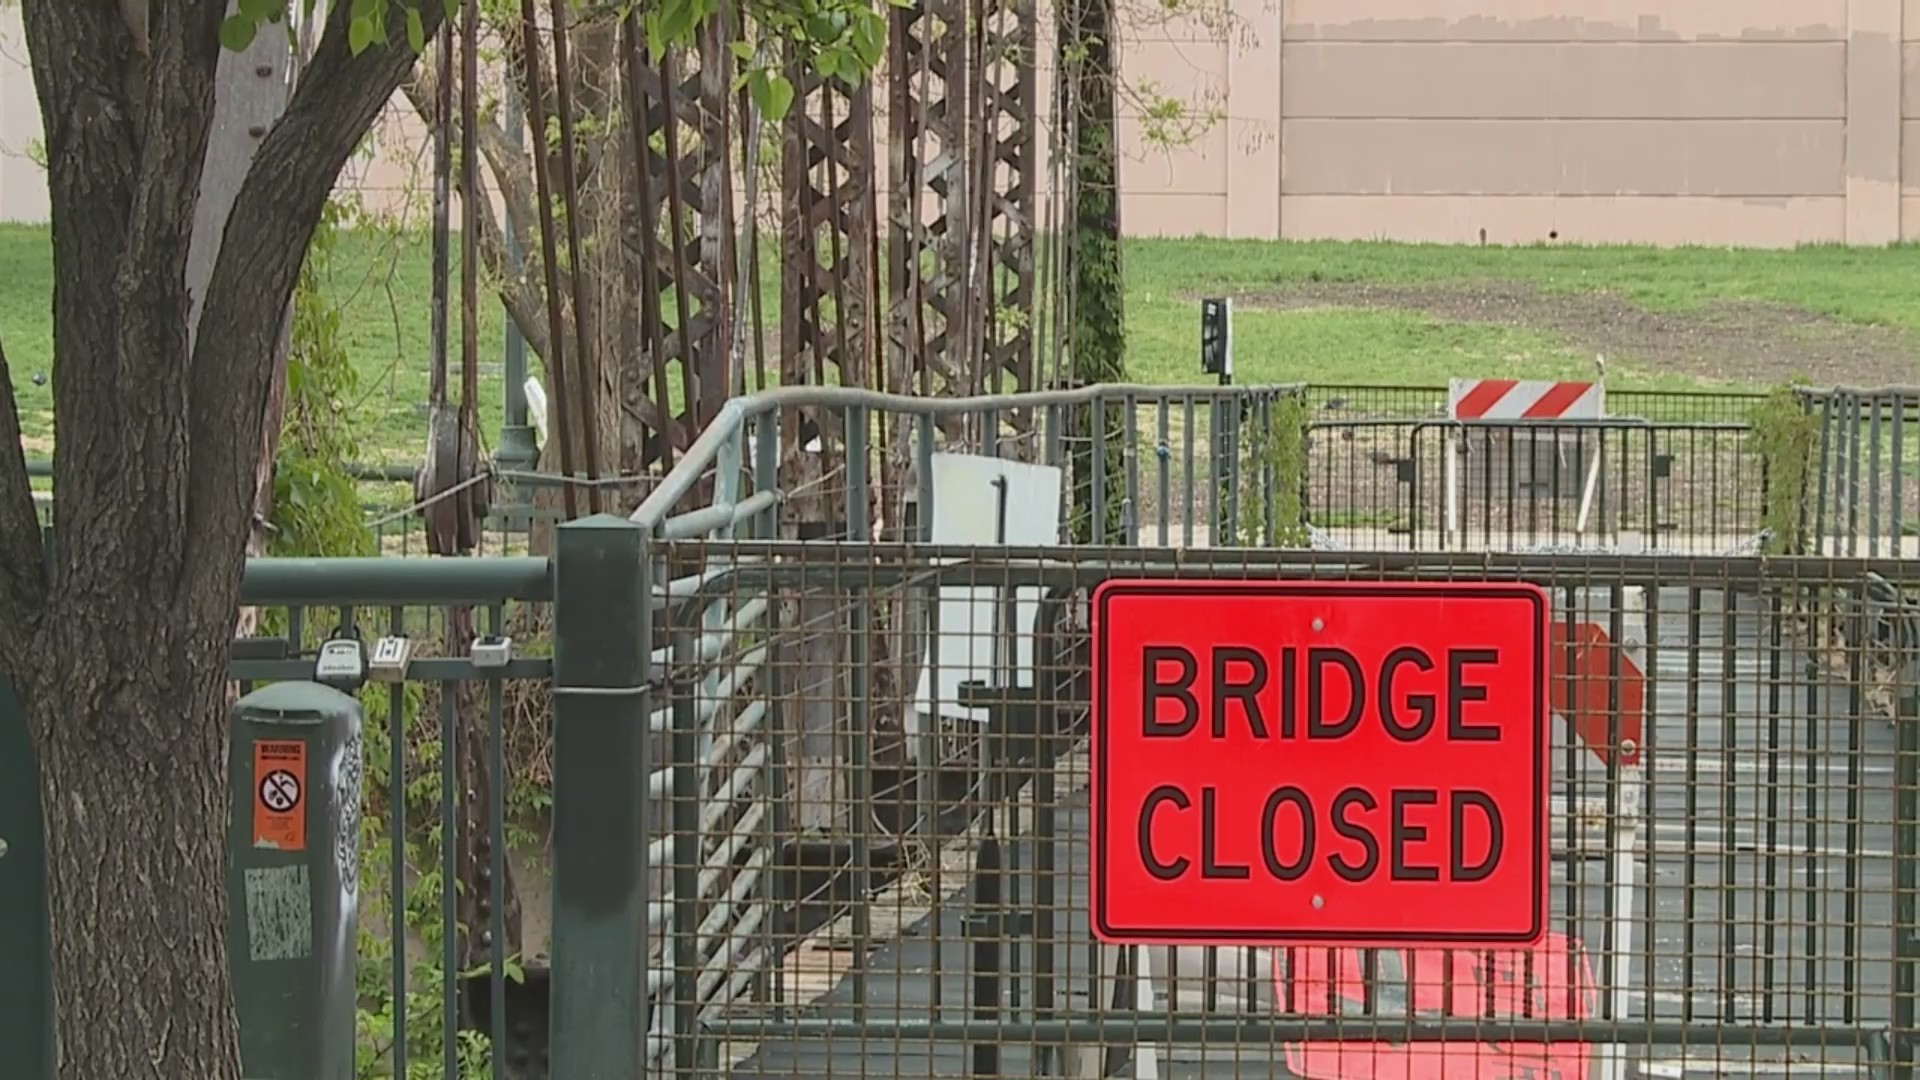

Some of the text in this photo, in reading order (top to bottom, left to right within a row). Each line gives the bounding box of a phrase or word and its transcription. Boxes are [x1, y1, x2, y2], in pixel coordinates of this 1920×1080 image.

[1142, 645, 1501, 742] BRIDGE
[260, 744, 301, 754] WARNING
[1138, 785, 1504, 883] CLOSED
